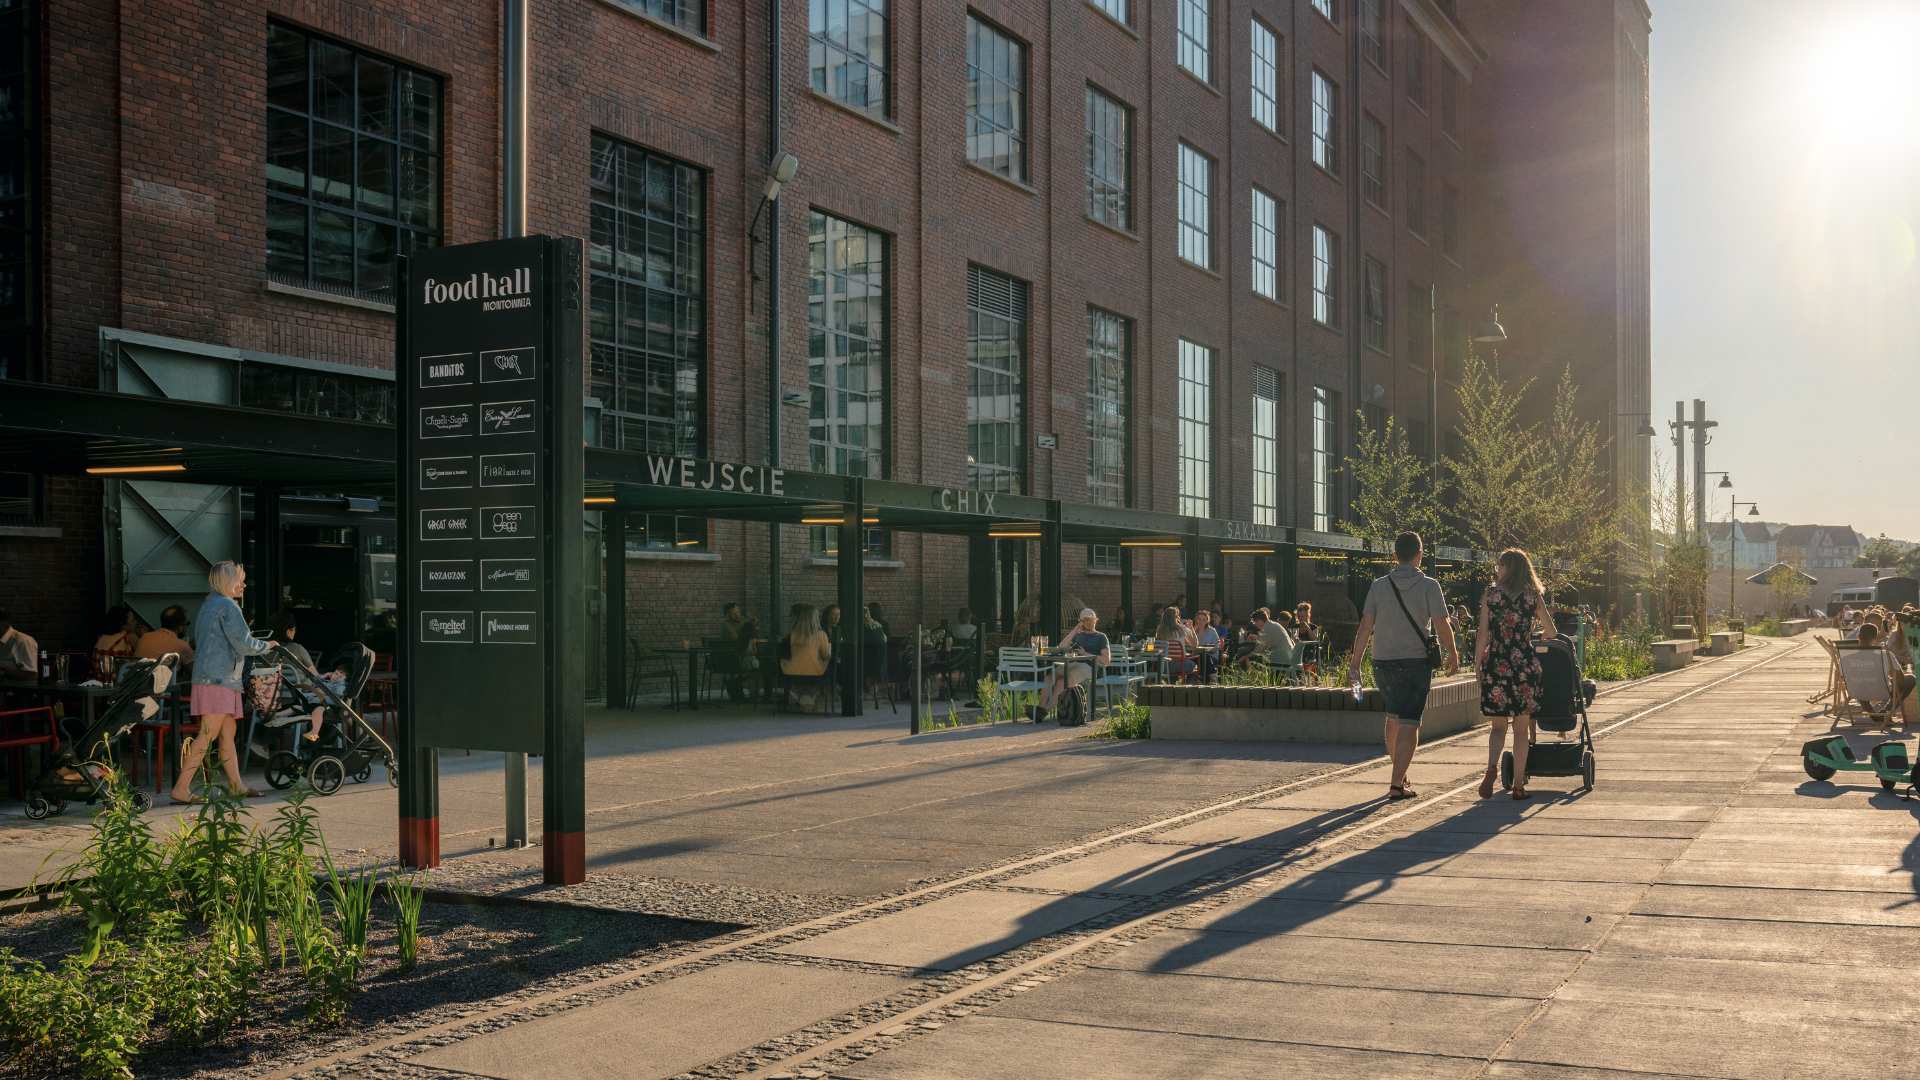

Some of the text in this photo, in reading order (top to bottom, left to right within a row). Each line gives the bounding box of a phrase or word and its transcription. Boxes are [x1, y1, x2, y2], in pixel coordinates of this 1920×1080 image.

[424, 268, 531, 304] food hall
[647, 455, 785, 496] WEJSCIE
[941, 488, 995, 515] CHIX
[428, 518, 467, 531] GREAT GREEK
